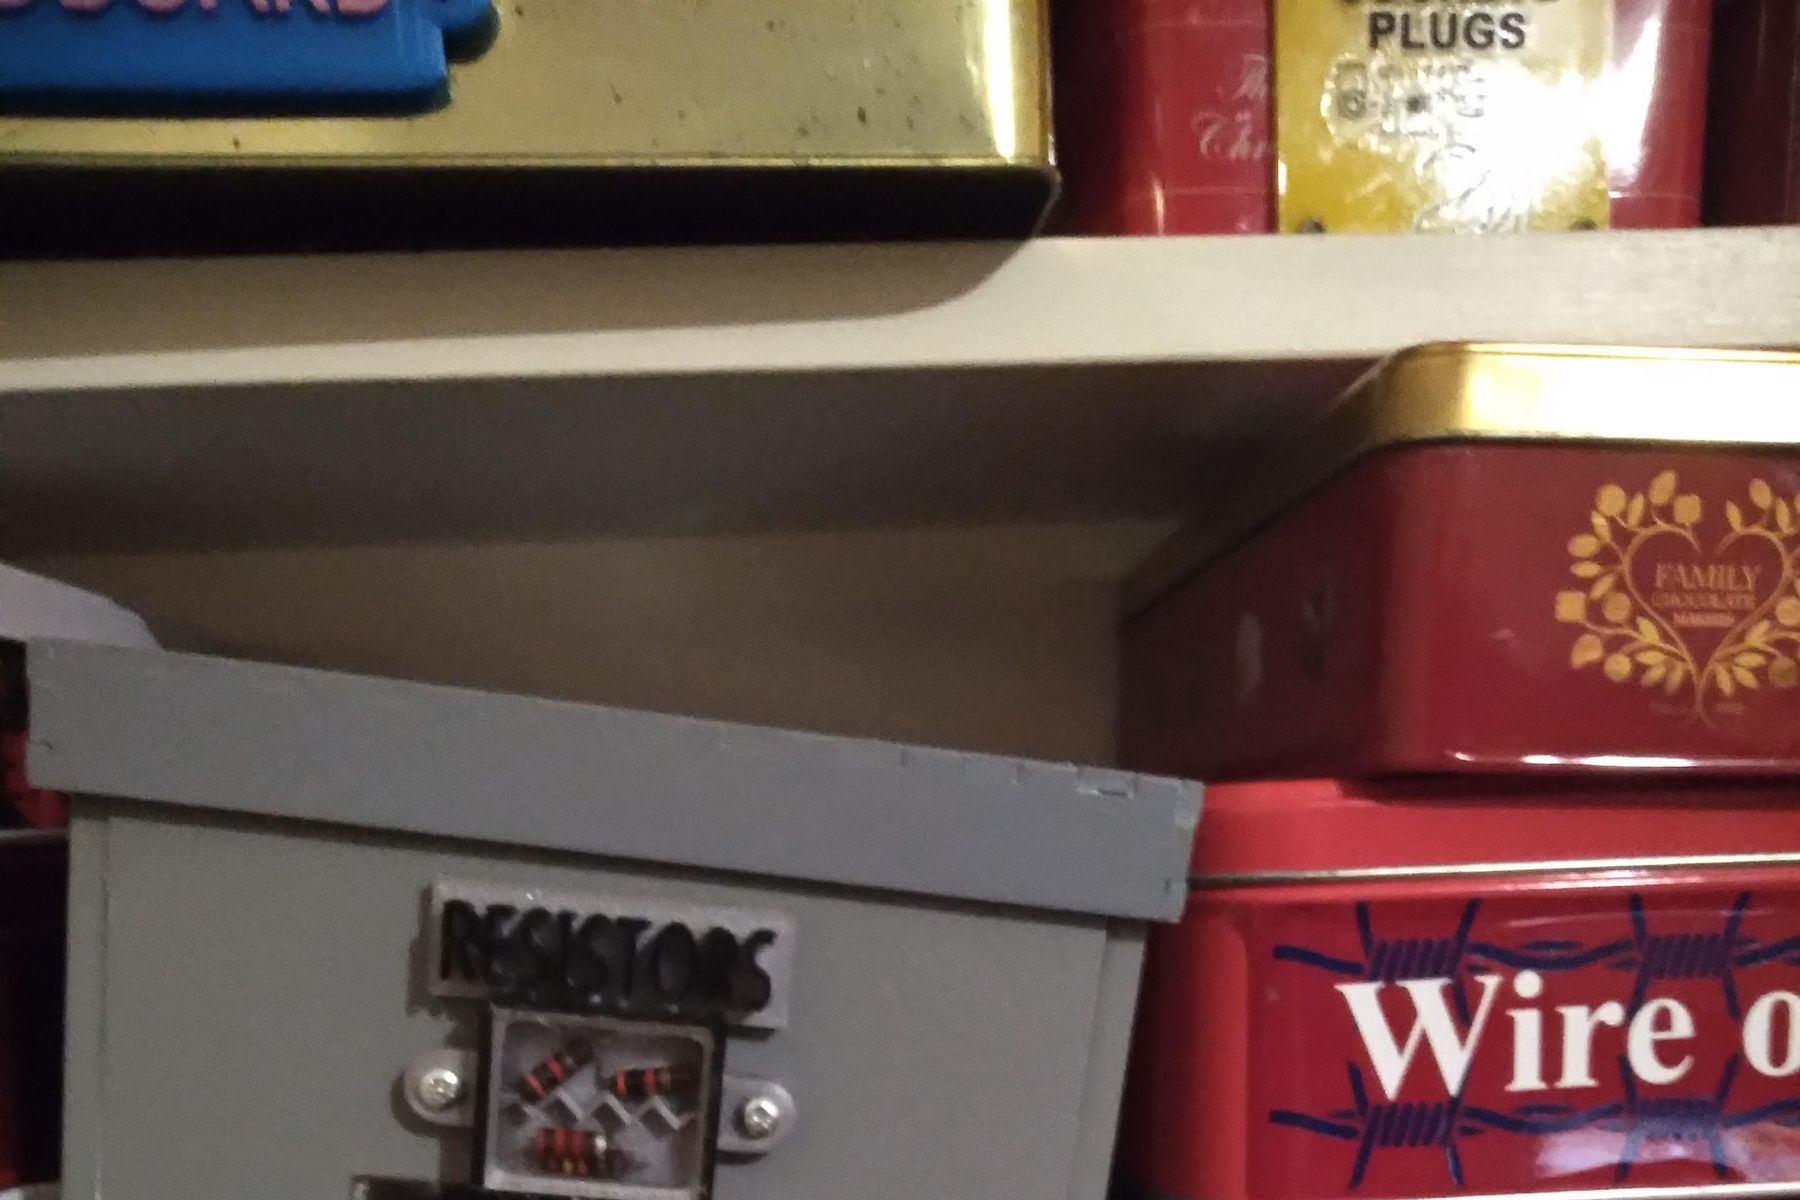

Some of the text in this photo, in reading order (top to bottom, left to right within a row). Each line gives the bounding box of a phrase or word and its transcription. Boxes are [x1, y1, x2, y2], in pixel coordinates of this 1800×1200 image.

[1368, 11, 1527, 50] PLUGS
[441, 898, 777, 1014] RESISTORS
[1335, 970, 1695, 1101] Wire
